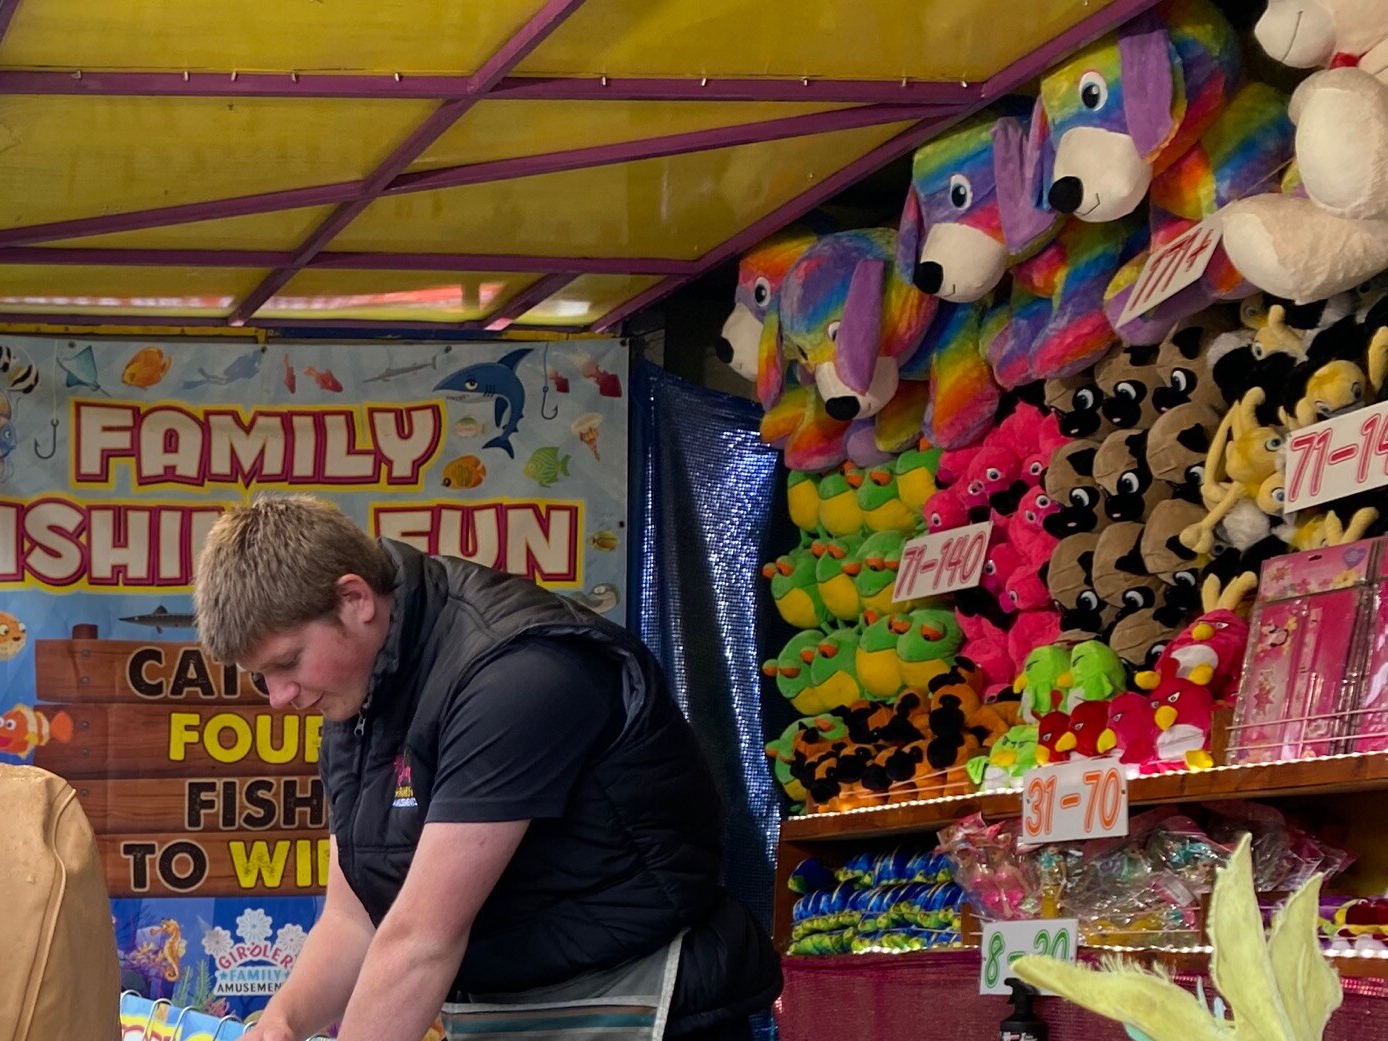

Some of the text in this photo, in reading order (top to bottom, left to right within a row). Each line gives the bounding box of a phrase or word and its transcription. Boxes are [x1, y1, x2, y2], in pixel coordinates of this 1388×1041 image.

[75, 401, 442, 488] FAMILY
[374, 502, 579, 582] FUN
[895, 531, 987, 599] 71-140
[185, 776, 326, 831] FISH
[120, 838, 209, 893] TO
[218, 942, 294, 970] GIRDLER
[229, 969, 283, 981] FAMILY
[217, 982, 283, 993] AMUSEMEN
